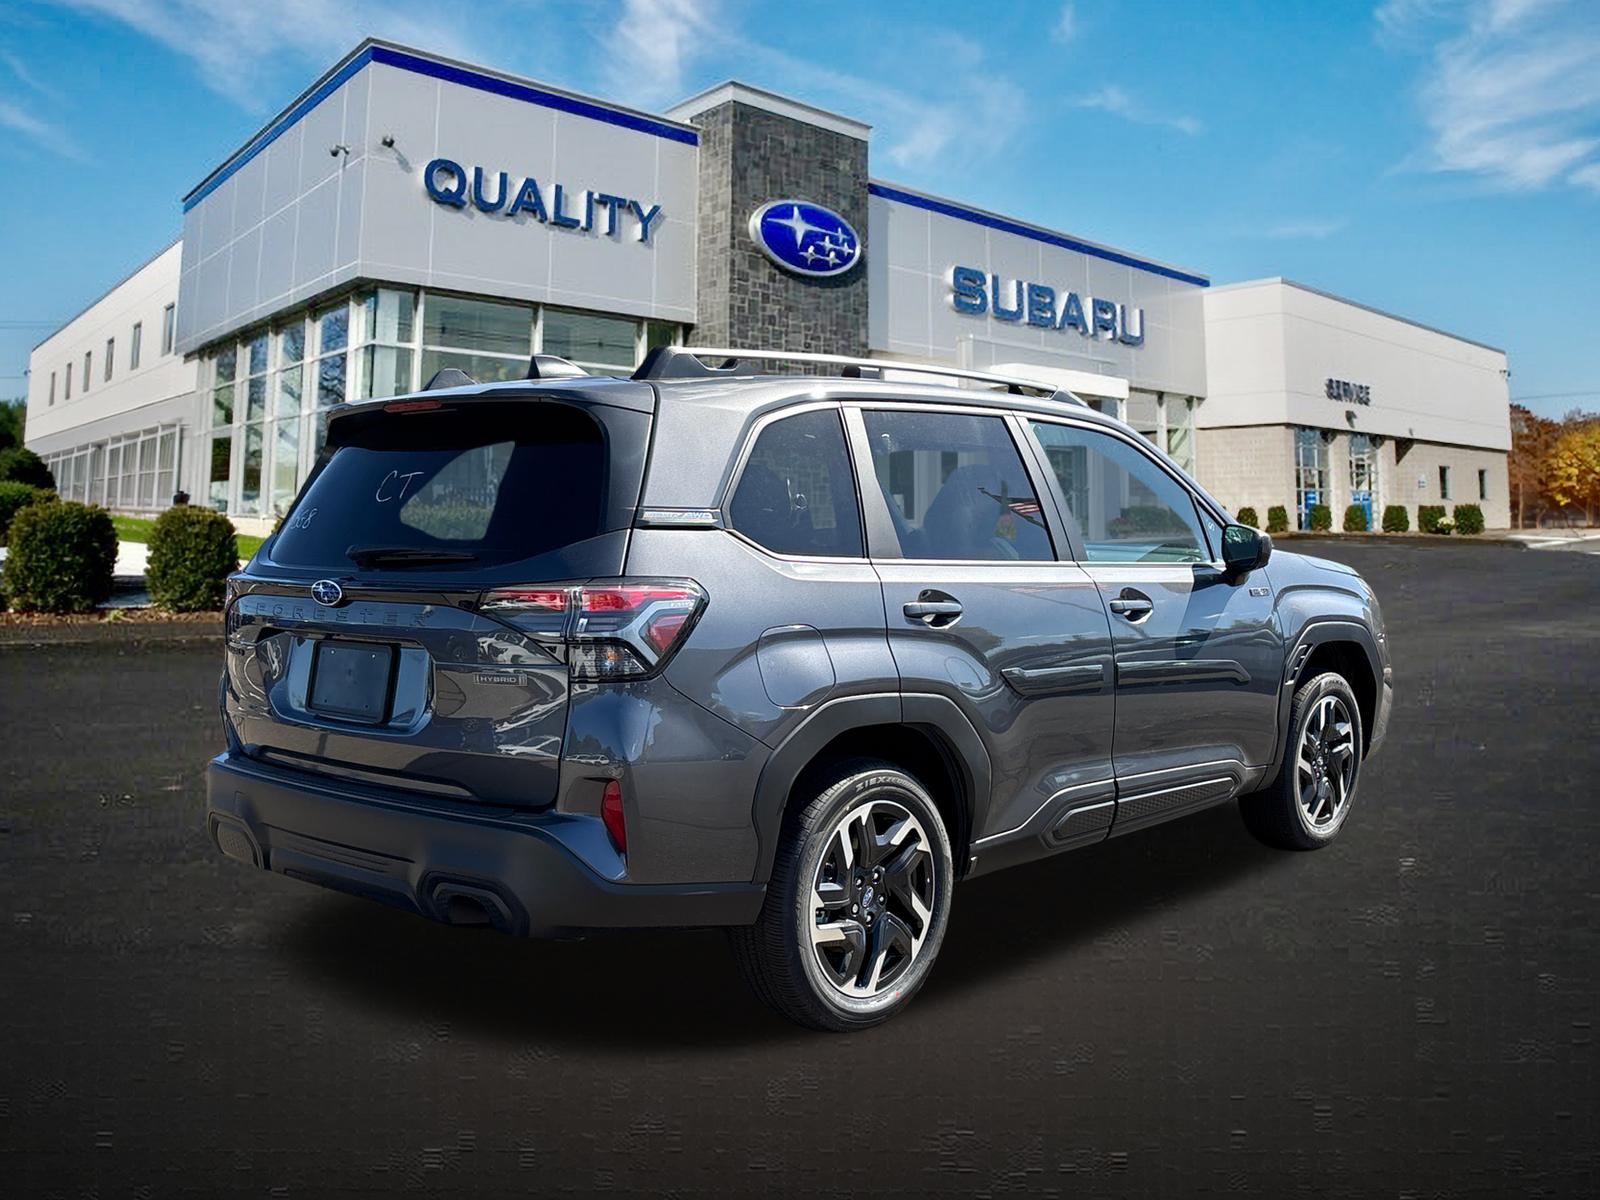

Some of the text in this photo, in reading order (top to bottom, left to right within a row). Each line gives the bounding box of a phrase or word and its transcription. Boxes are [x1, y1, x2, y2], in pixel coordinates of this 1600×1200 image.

[424, 158, 661, 242] QUALITY
[952, 265, 1145, 346] SUBARU
[376, 470, 424, 502] CT
[256, 602, 426, 627] FORESTER
